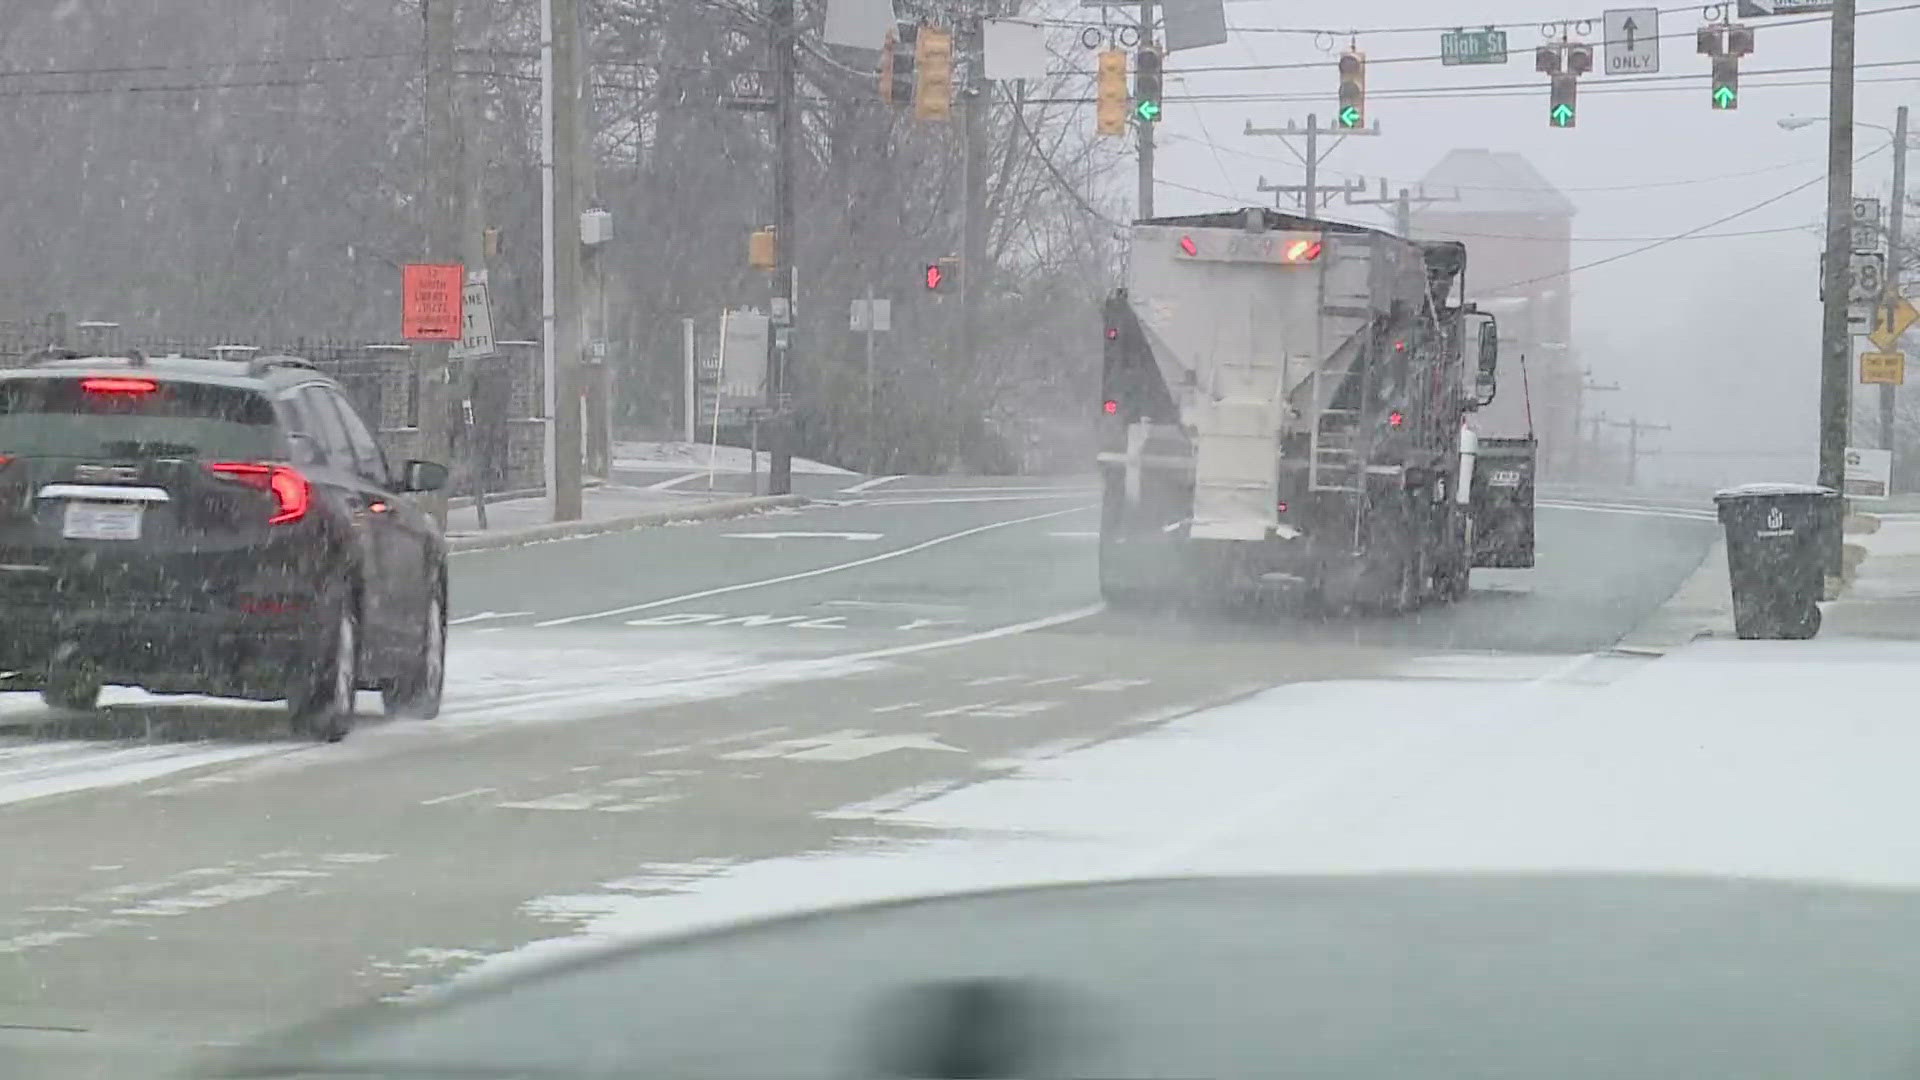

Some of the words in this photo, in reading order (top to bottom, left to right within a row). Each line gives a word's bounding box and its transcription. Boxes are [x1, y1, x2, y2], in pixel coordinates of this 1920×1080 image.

[1443, 34, 1479, 56] High
[1487, 33, 1504, 53] St
[1612, 54, 1651, 70] ONLY
[463, 335, 489, 349] LEFT
